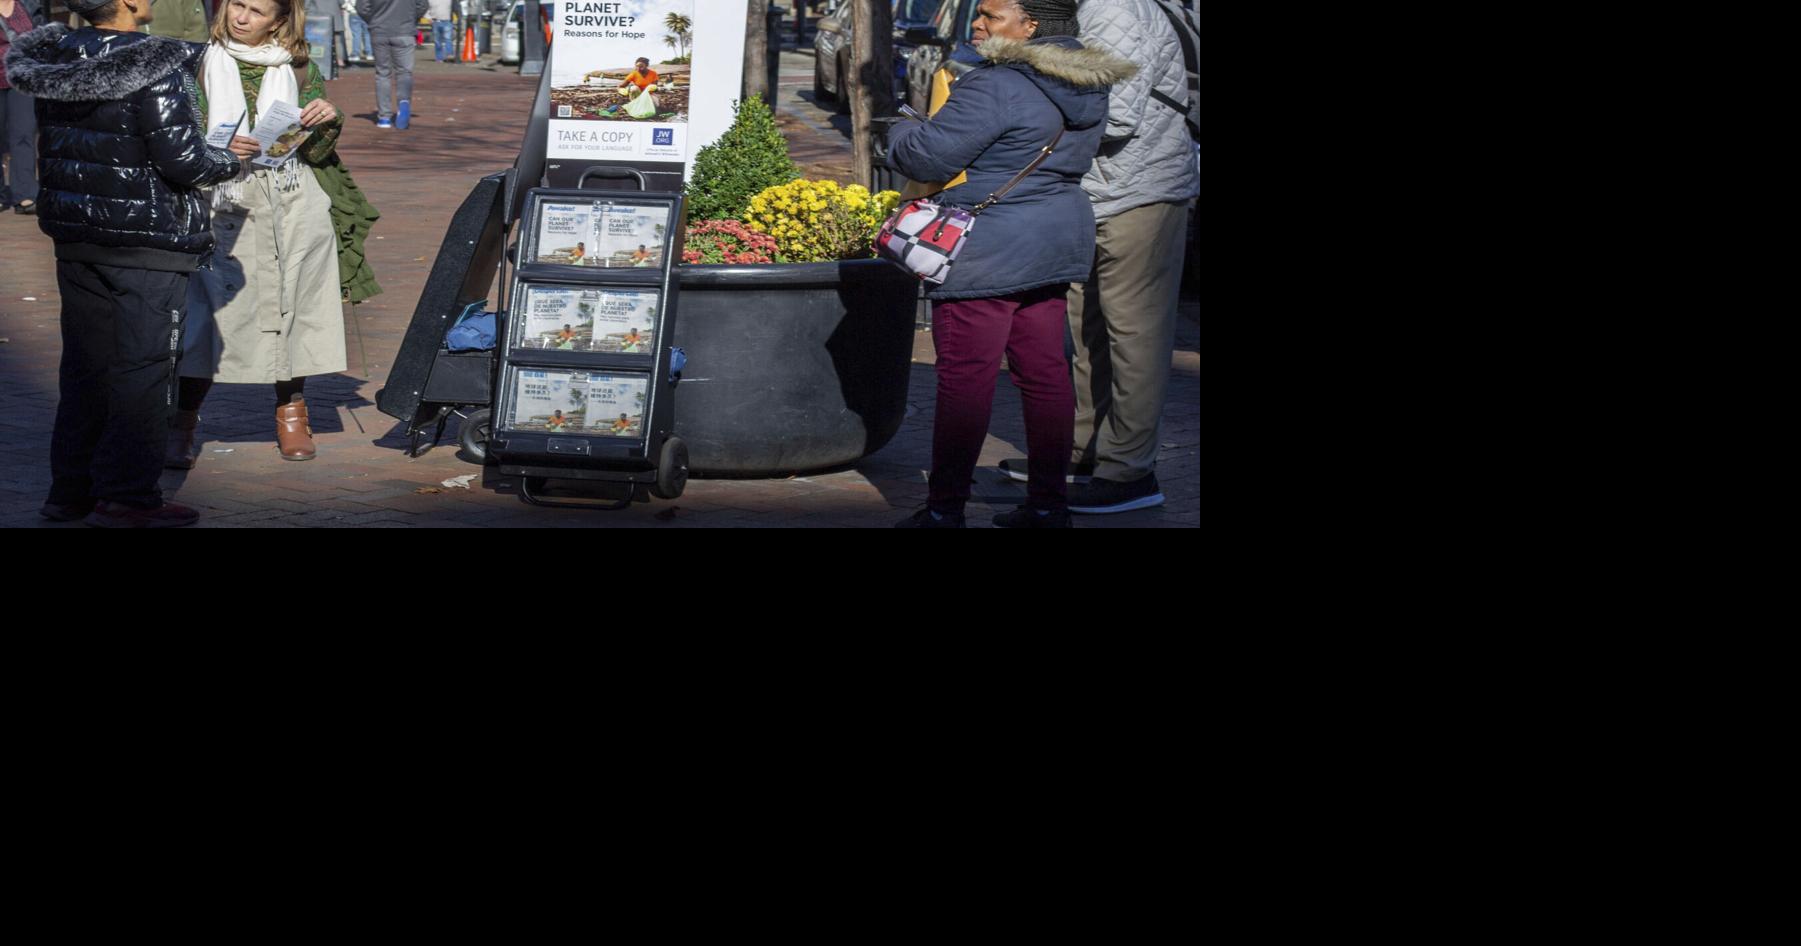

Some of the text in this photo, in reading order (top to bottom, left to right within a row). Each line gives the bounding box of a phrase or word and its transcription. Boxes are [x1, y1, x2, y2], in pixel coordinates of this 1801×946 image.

[565, 2, 621, 13] PLANET
[565, 15, 635, 27] SURVIVE?
[564, 29, 646, 40] Reasons for Hope
[558, 130, 634, 143] TAKE A COPY
[656, 130, 671, 138] JW
